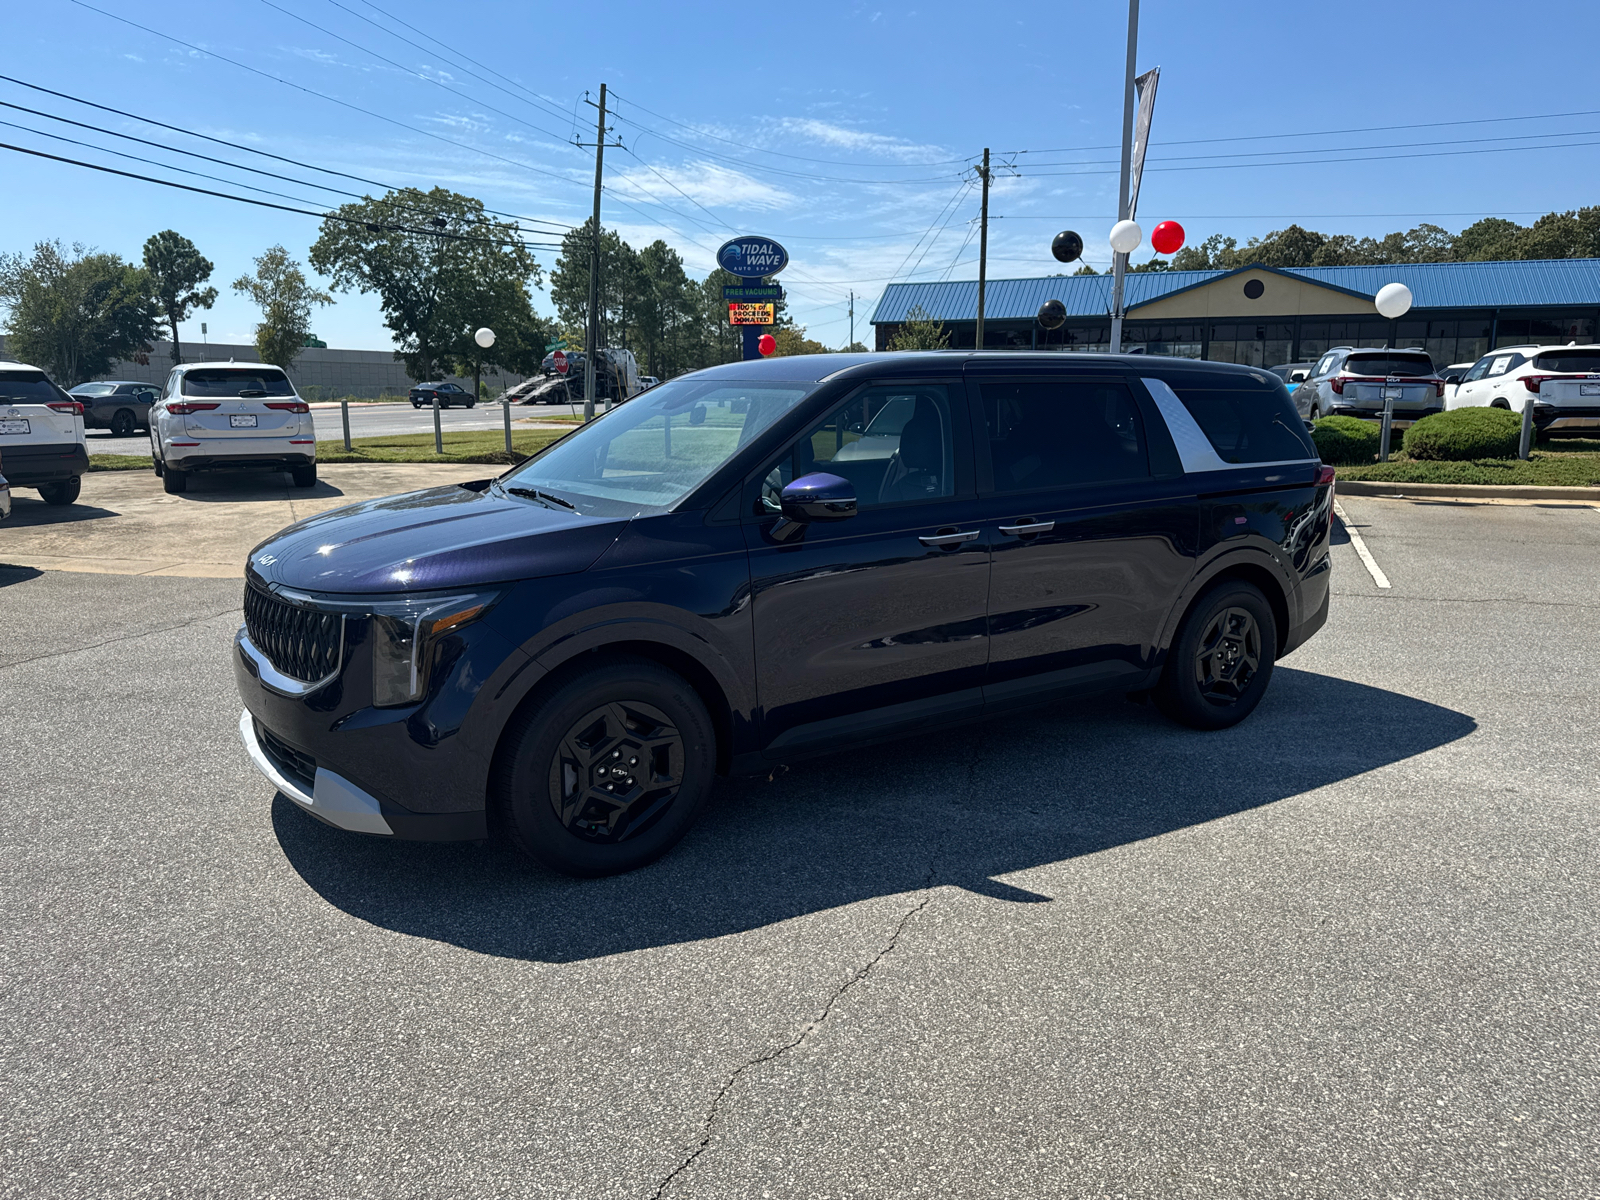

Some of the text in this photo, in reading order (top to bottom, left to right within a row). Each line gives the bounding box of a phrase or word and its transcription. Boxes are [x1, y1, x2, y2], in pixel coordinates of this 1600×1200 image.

[741, 244, 774, 254] TIDAL
[746, 255, 780, 265] WAVE
[725, 288, 777, 296] FREE VACUUMS
[554, 357, 567, 367] STOP
[257, 553, 278, 567] KIA
[672, 693, 704, 739] Dynapro
